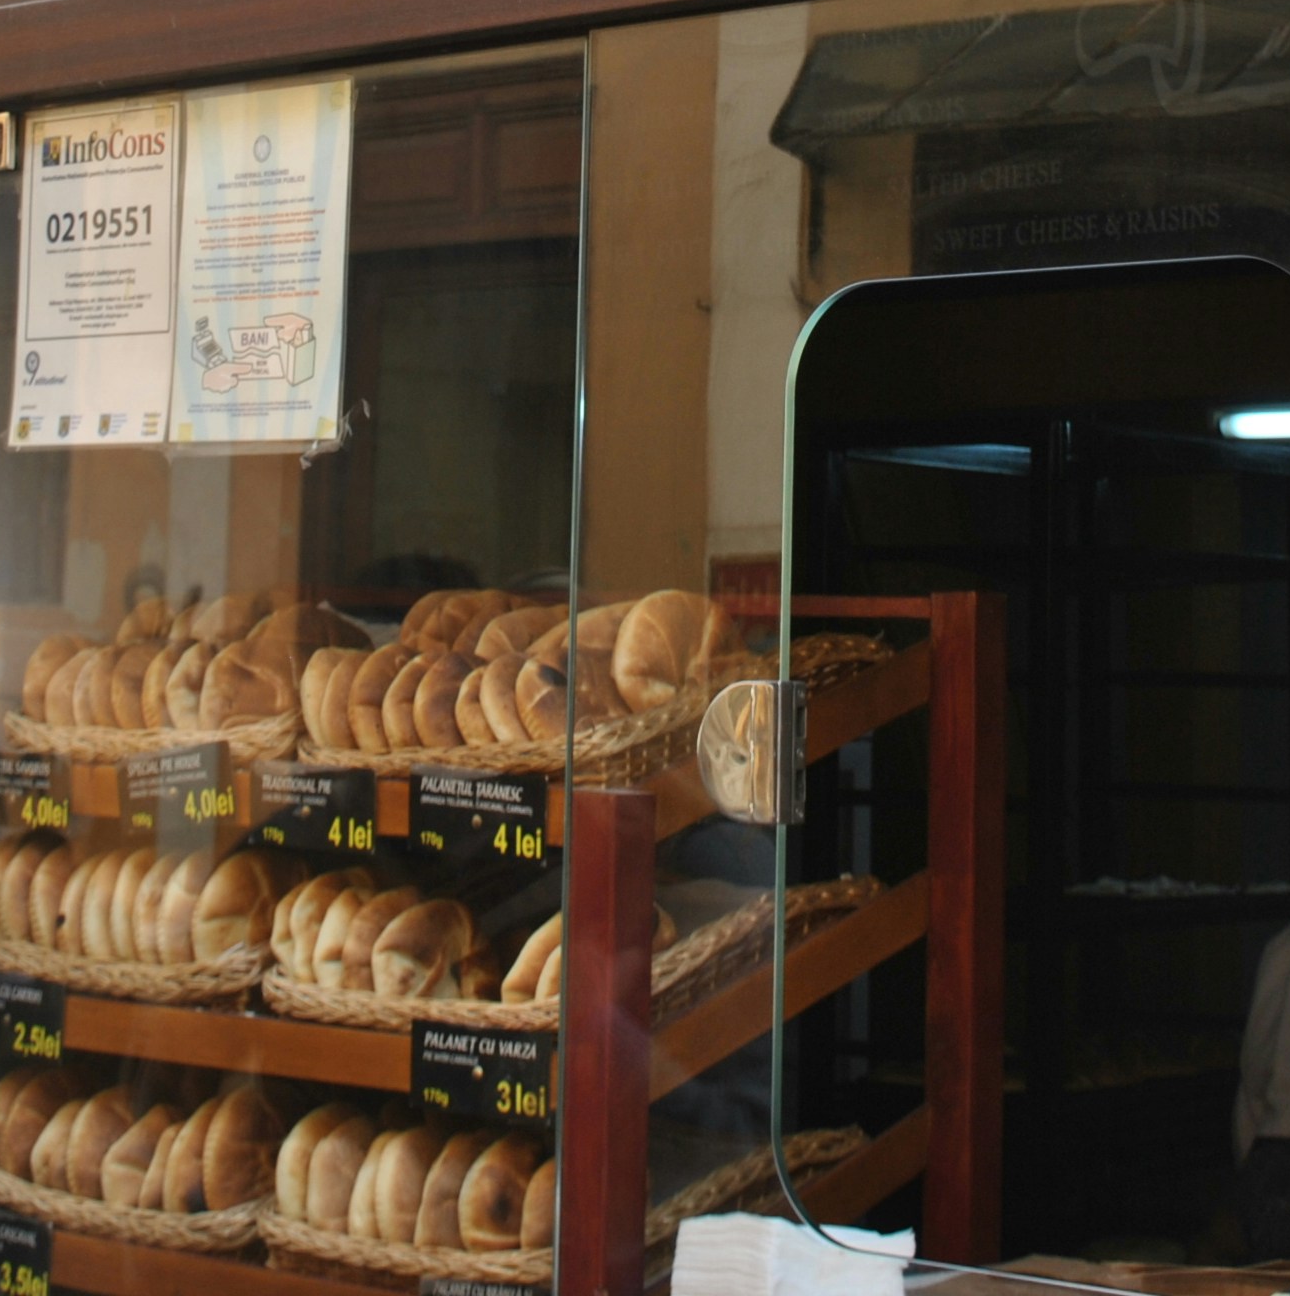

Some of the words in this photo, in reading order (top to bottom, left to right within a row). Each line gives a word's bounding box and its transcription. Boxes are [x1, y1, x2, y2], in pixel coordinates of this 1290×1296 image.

[64, 129, 166, 165] InfoCons
[46, 204, 152, 243] 0219551
[933, 223, 1007, 254] SWEET
[1014, 213, 1100, 246] CHEESE
[1126, 202, 1222, 237] RAISINS
[240, 332, 270, 346] BANI
[262, 774, 317, 793] TRADITIONAL
[317, 778, 333, 795] PIE
[184, 785, 235, 824] 4,0lei
[328, 815, 342, 847] 4
[347, 817, 373, 850] lei
[420, 830, 444, 851] 170g
[493, 822, 508, 856] 4
[515, 824, 543, 860] lei
[12, 1020, 62, 1060] 2,5lei
[478, 1036, 496, 1056] CU
[423, 1086, 449, 1109] 170g
[496, 1079, 512, 1114] 3
[515, 1081, 547, 1119] lei
